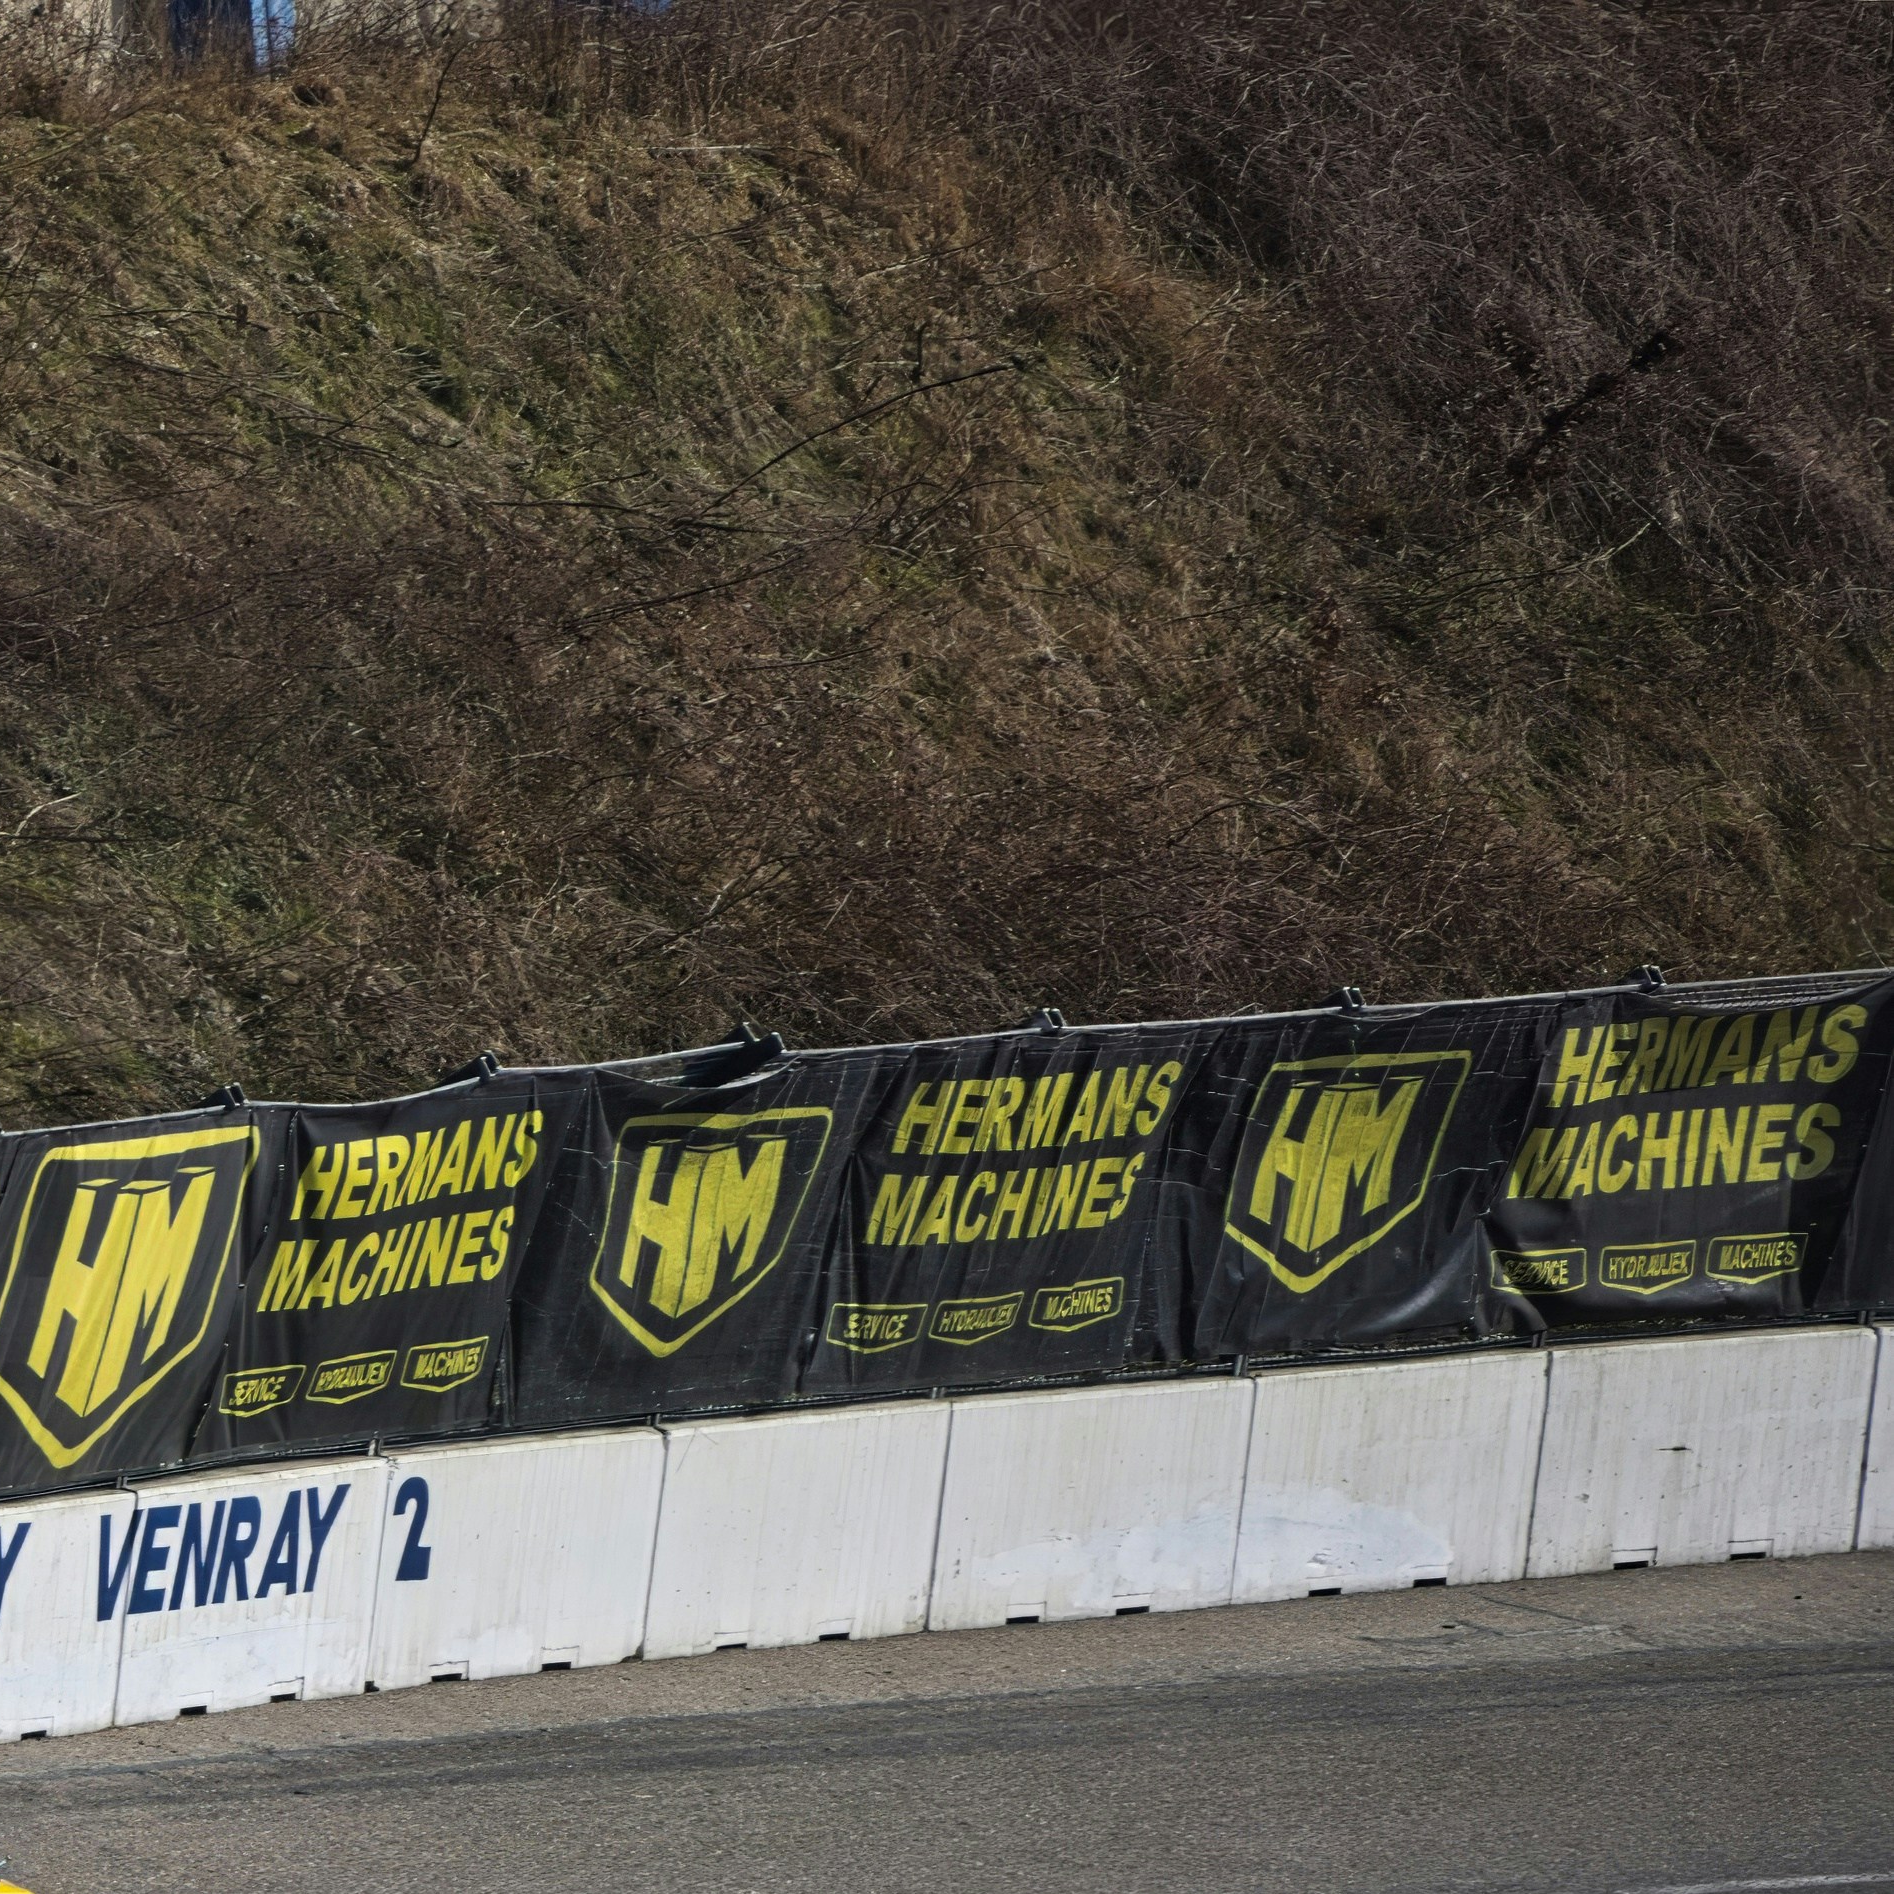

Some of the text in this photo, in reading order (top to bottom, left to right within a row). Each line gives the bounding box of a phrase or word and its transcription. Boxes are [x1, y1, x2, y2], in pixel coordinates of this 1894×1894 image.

[891, 1060, 1183, 1155] HERMANS
[1548, 1004, 1868, 1108] HERMANS
[290, 1110, 544, 1221] HERMANS
[862, 1152, 1146, 1246] MACHINES
[1249, 1076, 1425, 1252] HM
[1506, 1102, 1841, 1200] MACHINES
[256, 1205, 515, 1313] MACHINES
[619, 1134, 788, 1319] HM
[1719, 1240, 1797, 1271] MACHINES
[27, 1166, 216, 1418] HM
[843, 1312, 908, 1340] SERVICE
[413, 1345, 480, 1380] MACHINES
[96, 1483, 351, 1622] VENRAY
[393, 1476, 431, 1581] 2
